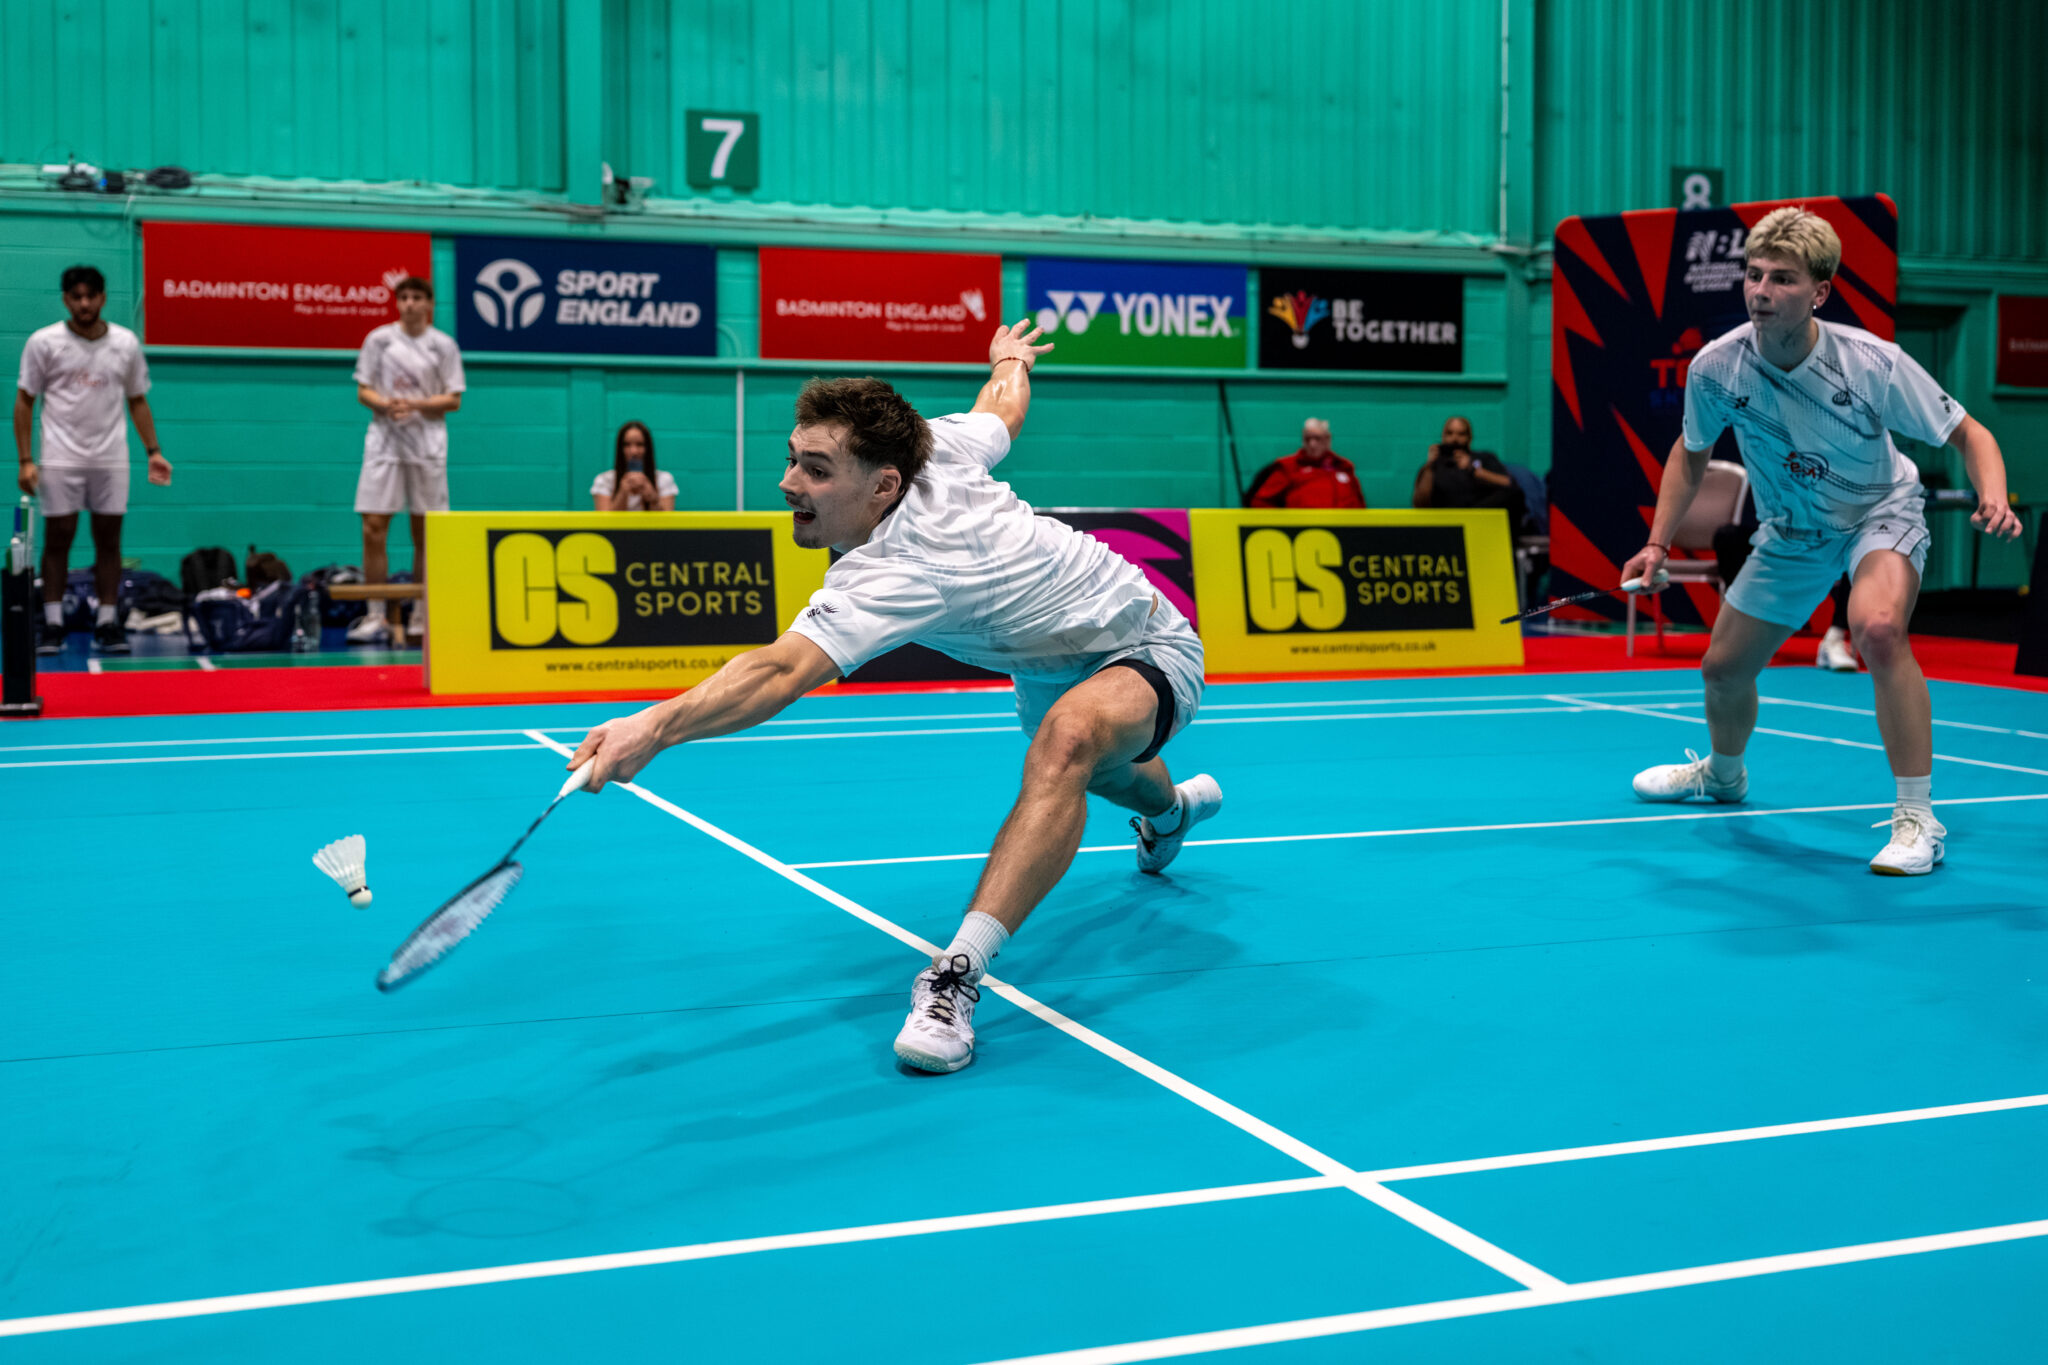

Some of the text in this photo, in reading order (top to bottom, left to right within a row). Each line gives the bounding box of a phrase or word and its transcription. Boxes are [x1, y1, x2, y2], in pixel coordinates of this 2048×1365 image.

[702, 118, 744, 178] 7
[163, 280, 390, 303] BADMINTON ENGLAND
[556, 269, 660, 299] SPORT
[556, 300, 701, 328] ENGLAND
[776, 298, 966, 321] BADMINTON ENGLAND
[1112, 292, 1233, 337] YONEX
[1332, 299, 1364, 321] BE
[1332, 319, 1457, 344] TOGETHER
[625, 562, 770, 587] CENTRAL
[1348, 554, 1465, 579] CENTRAL
[494, 532, 620, 647] CS
[1245, 528, 1347, 632] CS
[1357, 580, 1461, 605] SPORTS
[635, 591, 763, 617] SPORTS
[1290, 641, 1436, 656] www.centralsports.co.uk
